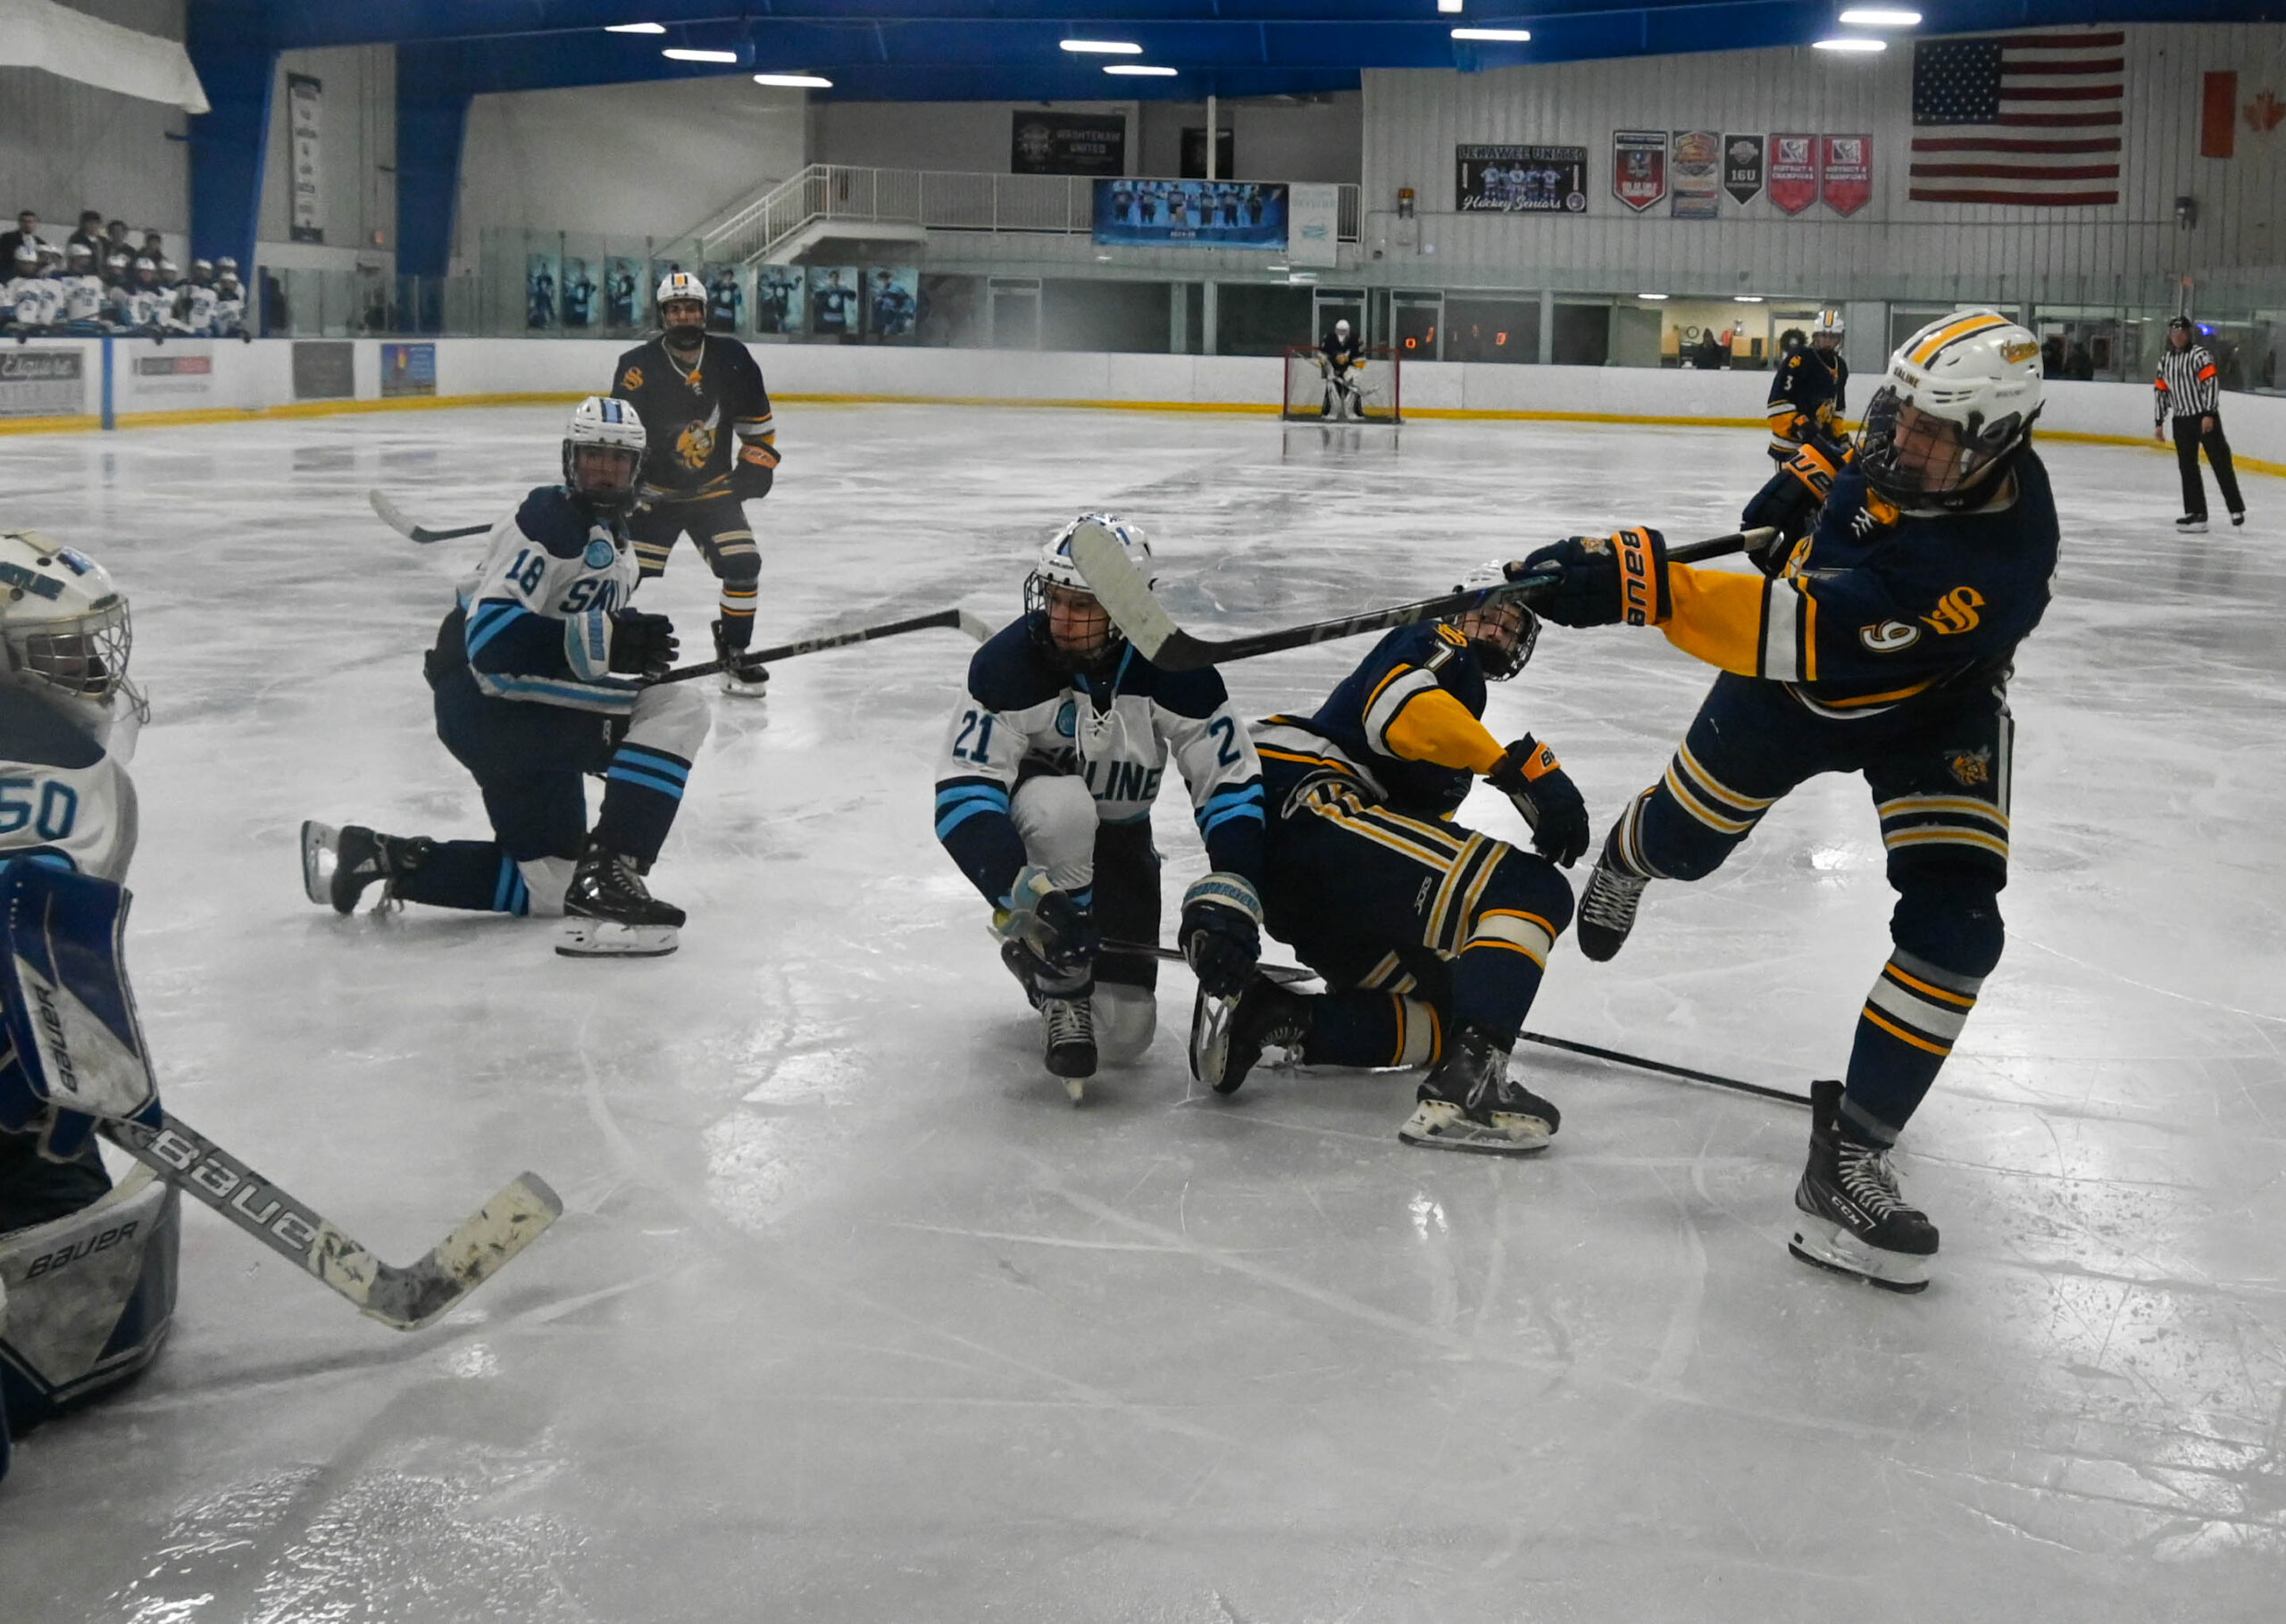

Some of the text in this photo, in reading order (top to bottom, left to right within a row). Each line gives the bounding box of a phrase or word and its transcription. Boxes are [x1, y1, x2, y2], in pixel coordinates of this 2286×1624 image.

[1458, 146, 1586, 161] LENAWEE UNITED
[1731, 169, 1756, 181] 16U
[1463, 194, 1562, 212] Hockey Seniors
[1784, 375, 1794, 391] 3
[505, 548, 546, 597] 18
[1918, 586, 1986, 635] S
[952, 710, 997, 764] 21
[1209, 715, 1241, 768] 2
[0, 778, 79, 841] 50
[1831, 1195, 1861, 1225] CCM
[25, 1220, 139, 1279] BAUER
